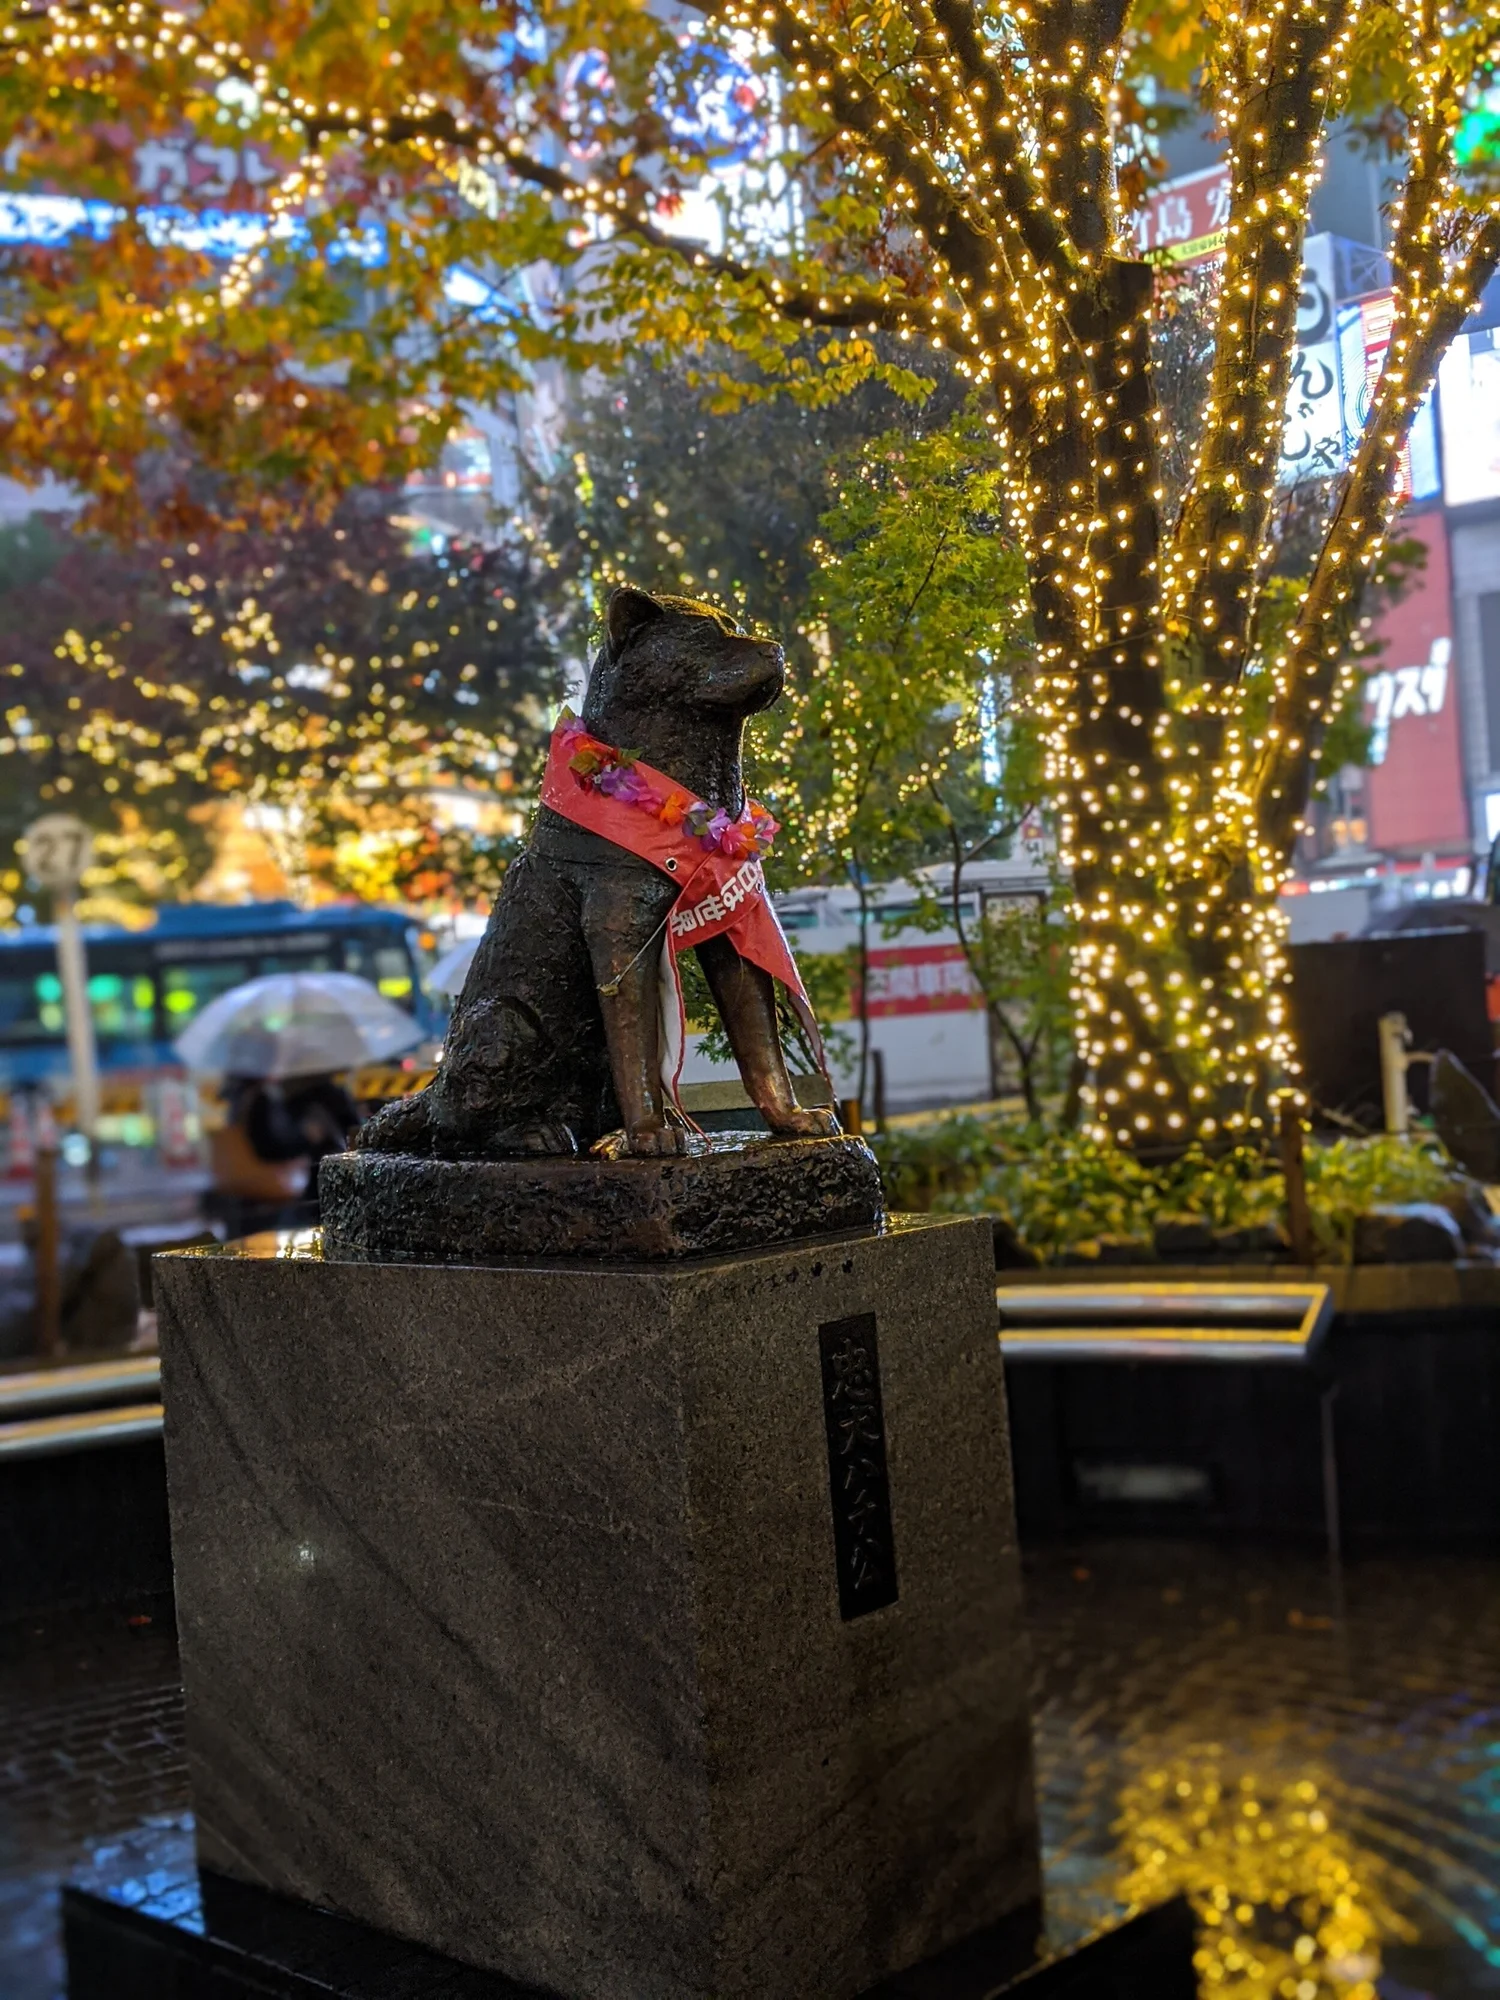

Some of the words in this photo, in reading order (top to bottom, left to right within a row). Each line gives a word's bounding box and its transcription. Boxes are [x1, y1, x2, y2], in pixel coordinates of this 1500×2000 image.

[33, 831, 84, 876] 27
[831, 1337, 883, 1591] 忠犬ハチ公
